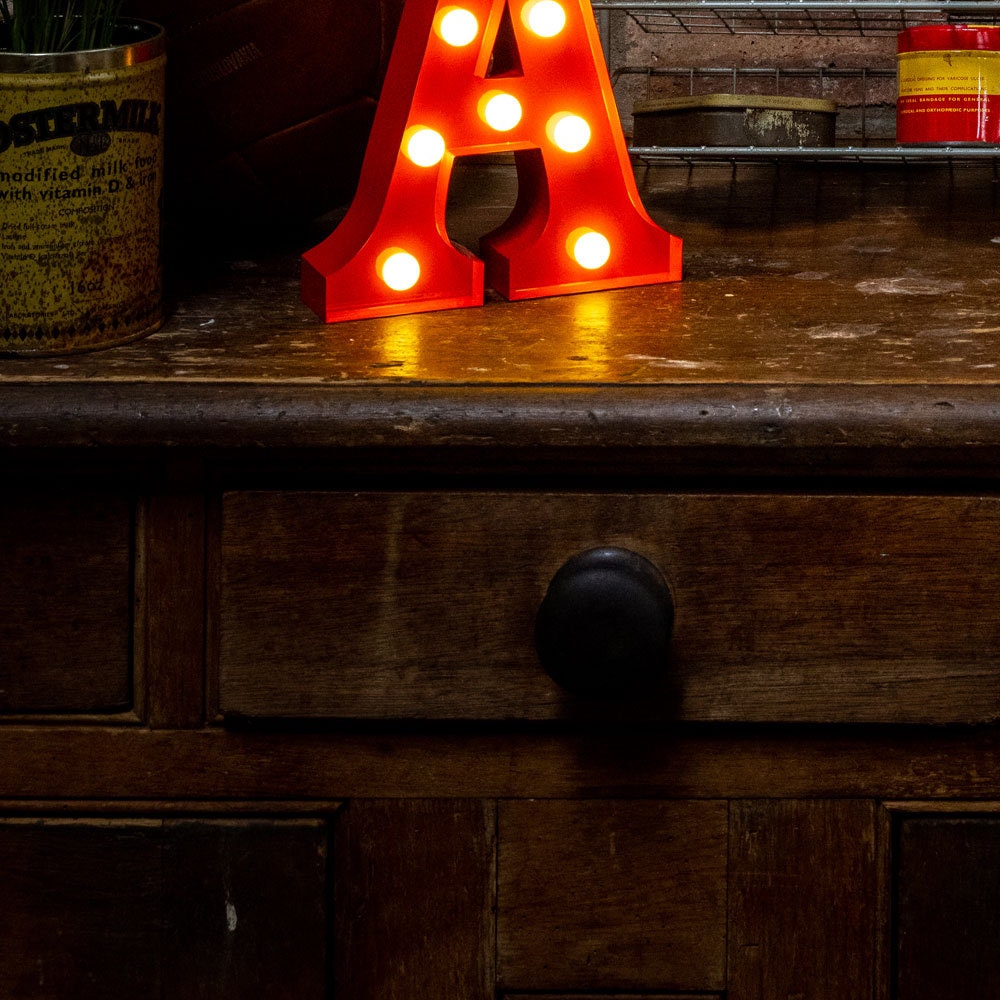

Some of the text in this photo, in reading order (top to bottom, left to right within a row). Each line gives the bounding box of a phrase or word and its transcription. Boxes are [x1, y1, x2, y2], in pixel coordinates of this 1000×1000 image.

[92, 160, 127, 178] milk
[40, 184, 102, 200] vitamin
[108, 179, 120, 193] D
[126, 176, 135, 190] &
